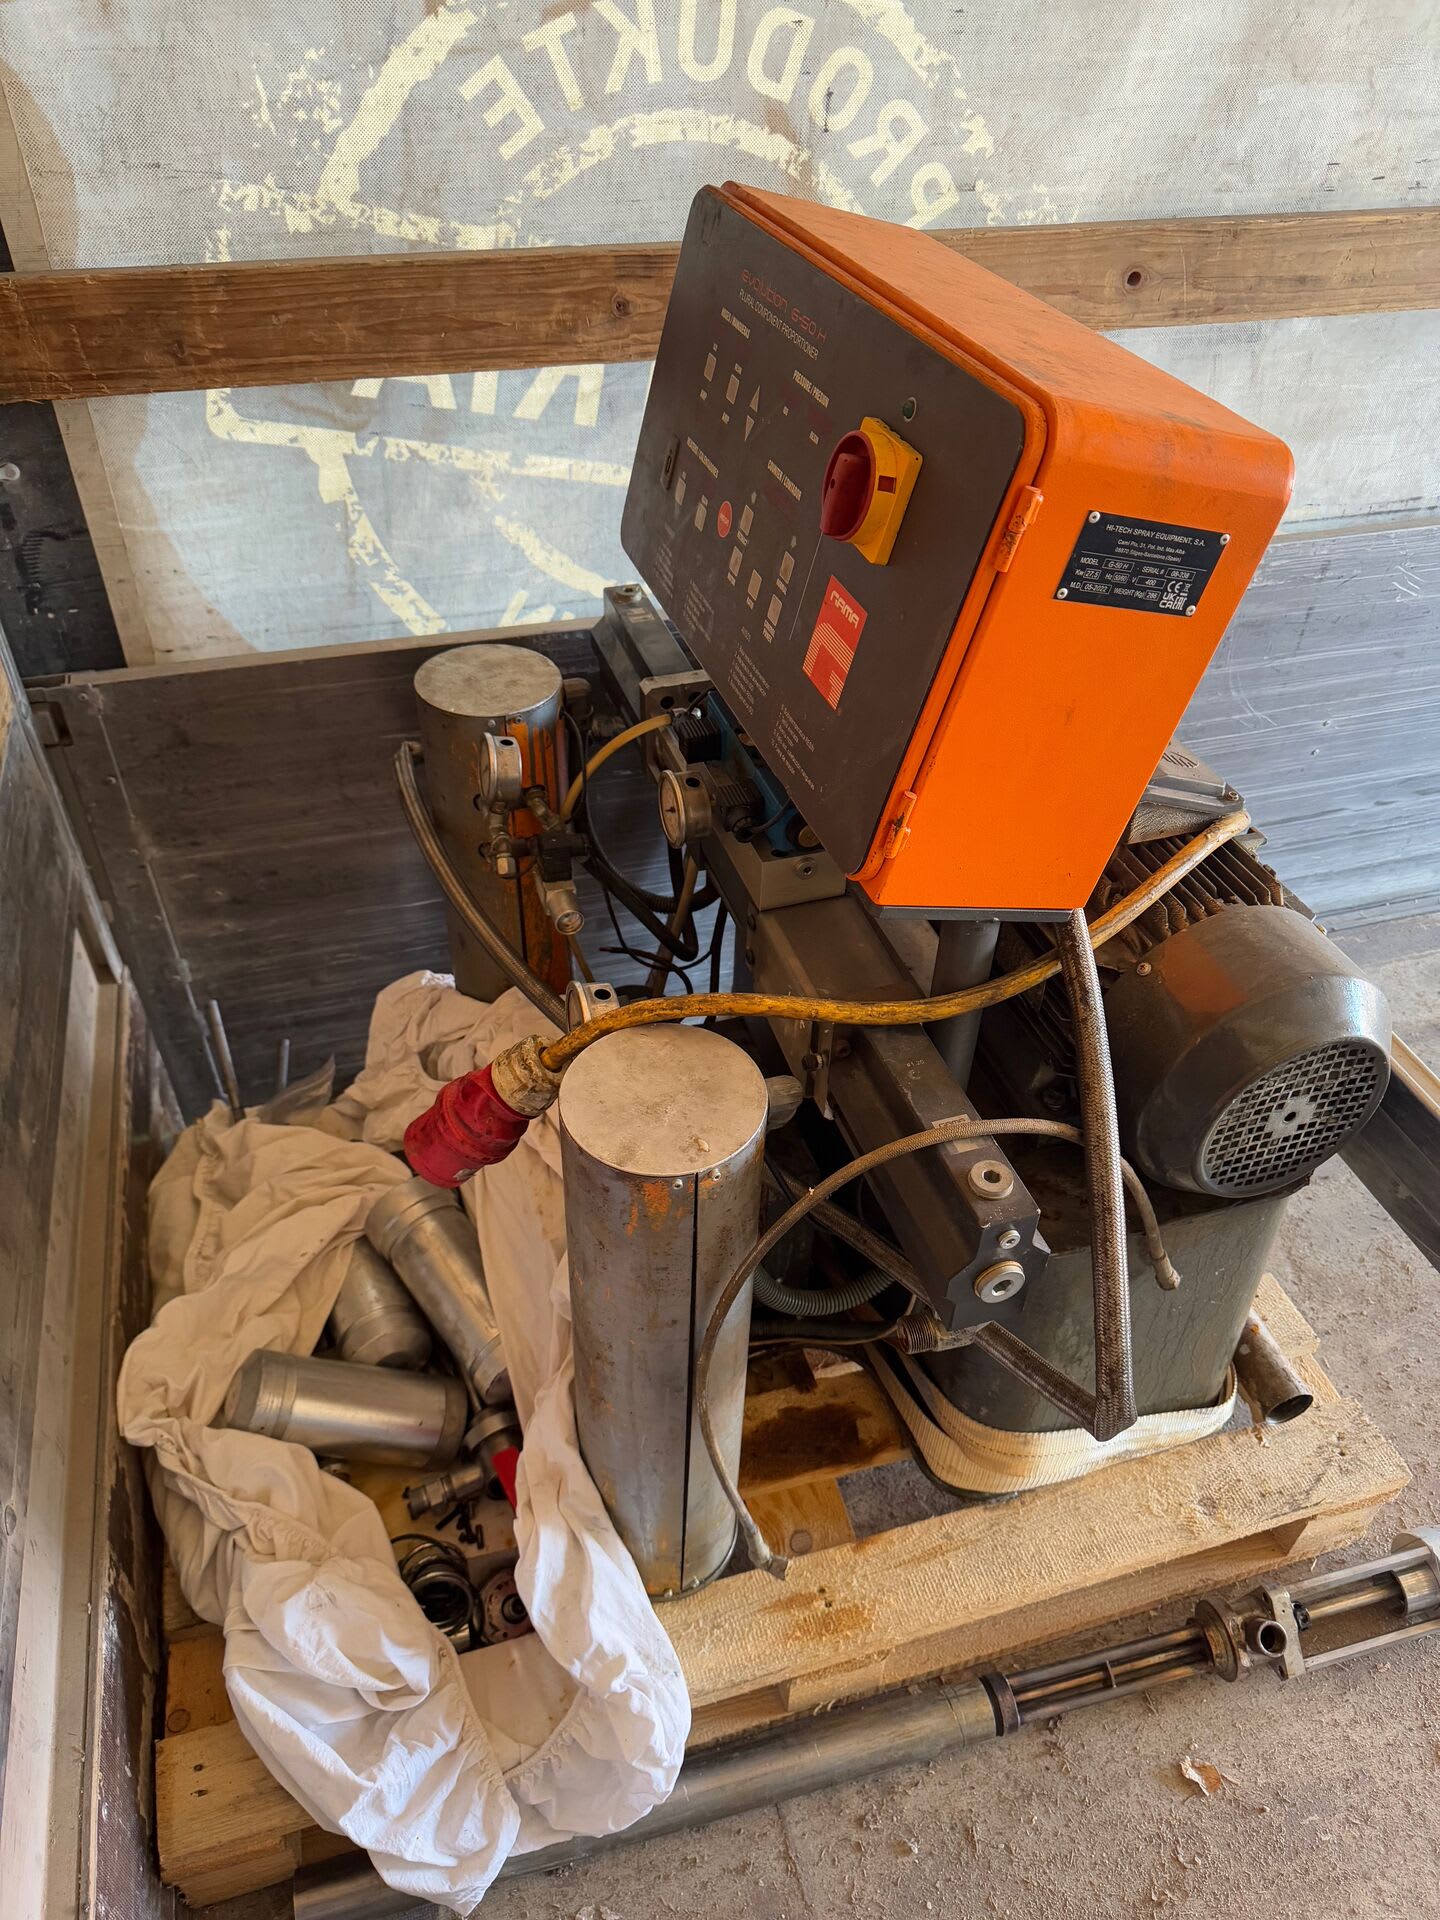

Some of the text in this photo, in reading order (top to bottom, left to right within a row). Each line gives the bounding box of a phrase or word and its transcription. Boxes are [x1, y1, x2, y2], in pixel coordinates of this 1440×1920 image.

[739, 289, 819, 360] PLURAL COMPONENT PROPORTIONER
[1106, 525, 1133, 534] HI-TECH
[1133, 529, 1155, 538] SPRAY
[1155, 533, 1194, 545] EQUIPMENT,
[1080, 557, 1100, 565] MODEL
[1142, 566, 1161, 574] SERIAL
[1084, 584, 1108, 592] 05-2022
[1113, 588, 1135, 596] WEIGHT
[1166, 581, 1183, 593] CE
[830, 589, 860, 630] GAMA
[1158, 600, 1173, 608] CA
